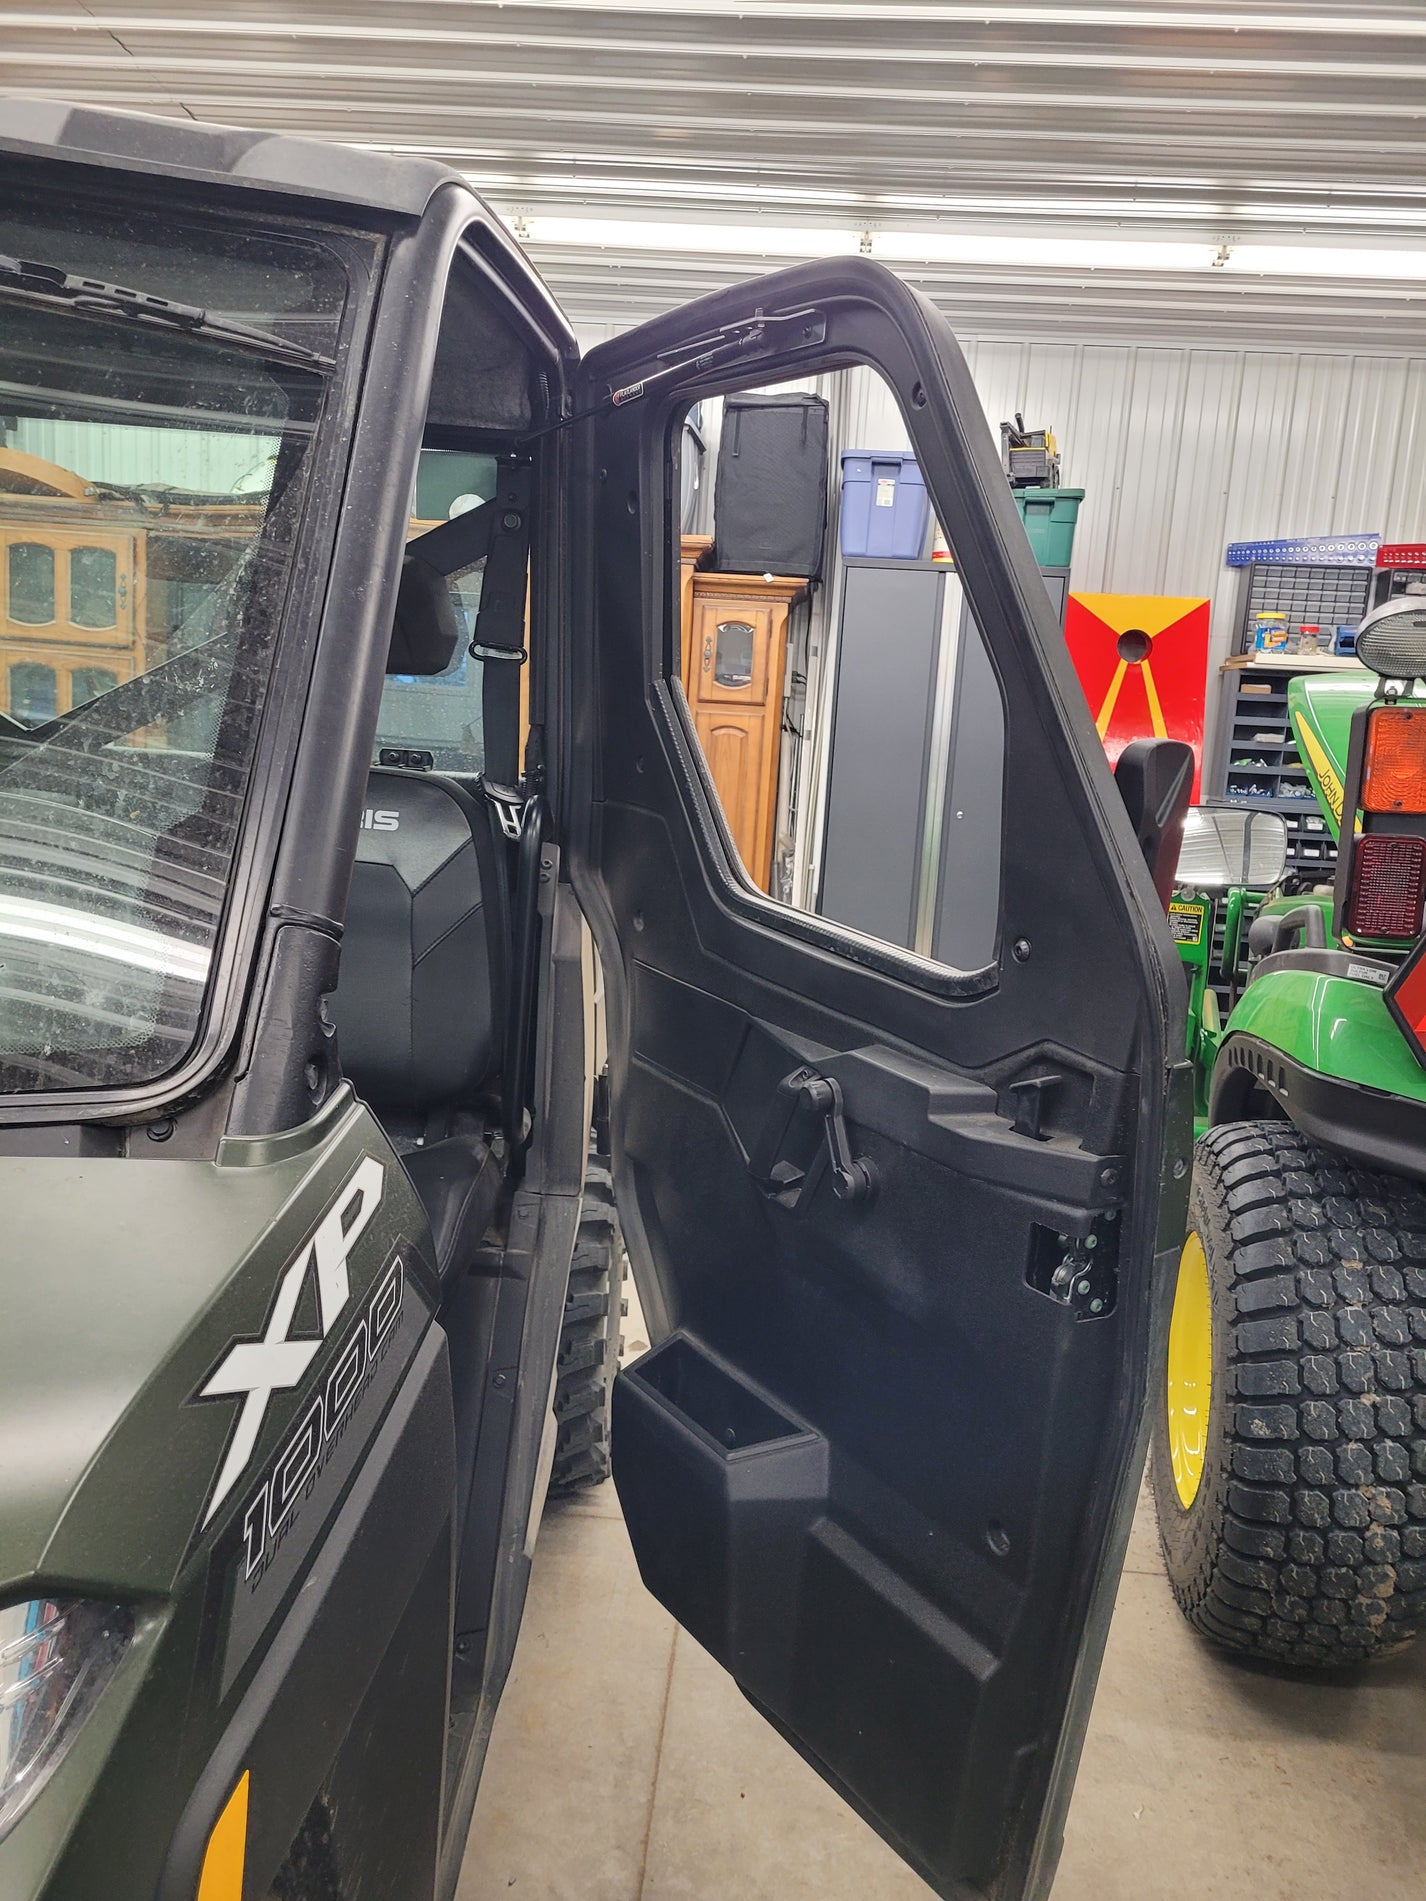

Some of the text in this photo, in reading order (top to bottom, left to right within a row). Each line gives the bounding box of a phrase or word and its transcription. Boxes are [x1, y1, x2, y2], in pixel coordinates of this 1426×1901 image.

[359, 809, 399, 831] IS
[1319, 769, 1339, 806] JOHN
[1178, 904, 1202, 913] CAUTION
[200, 1155, 384, 1532] XP
[244, 1255, 404, 1580] 1000
[251, 1509, 300, 1594] DUAL
[304, 1363, 379, 1501] OVERHEAD
